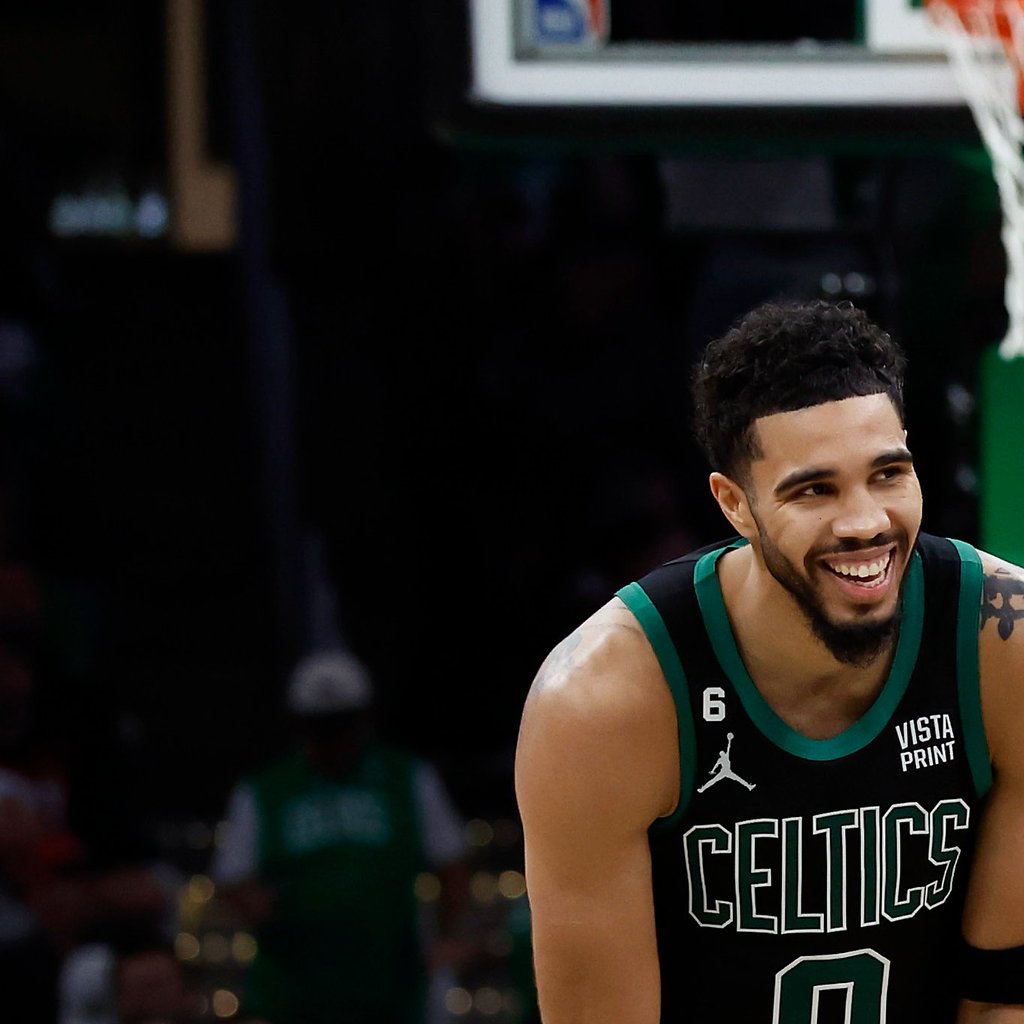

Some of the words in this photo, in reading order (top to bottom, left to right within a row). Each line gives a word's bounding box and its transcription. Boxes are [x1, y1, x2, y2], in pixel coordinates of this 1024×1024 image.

[702, 687, 727, 722] 6
[895, 713, 955, 750] VISTA
[900, 740, 956, 773] PRINT
[683, 798, 970, 935] CELTICS
